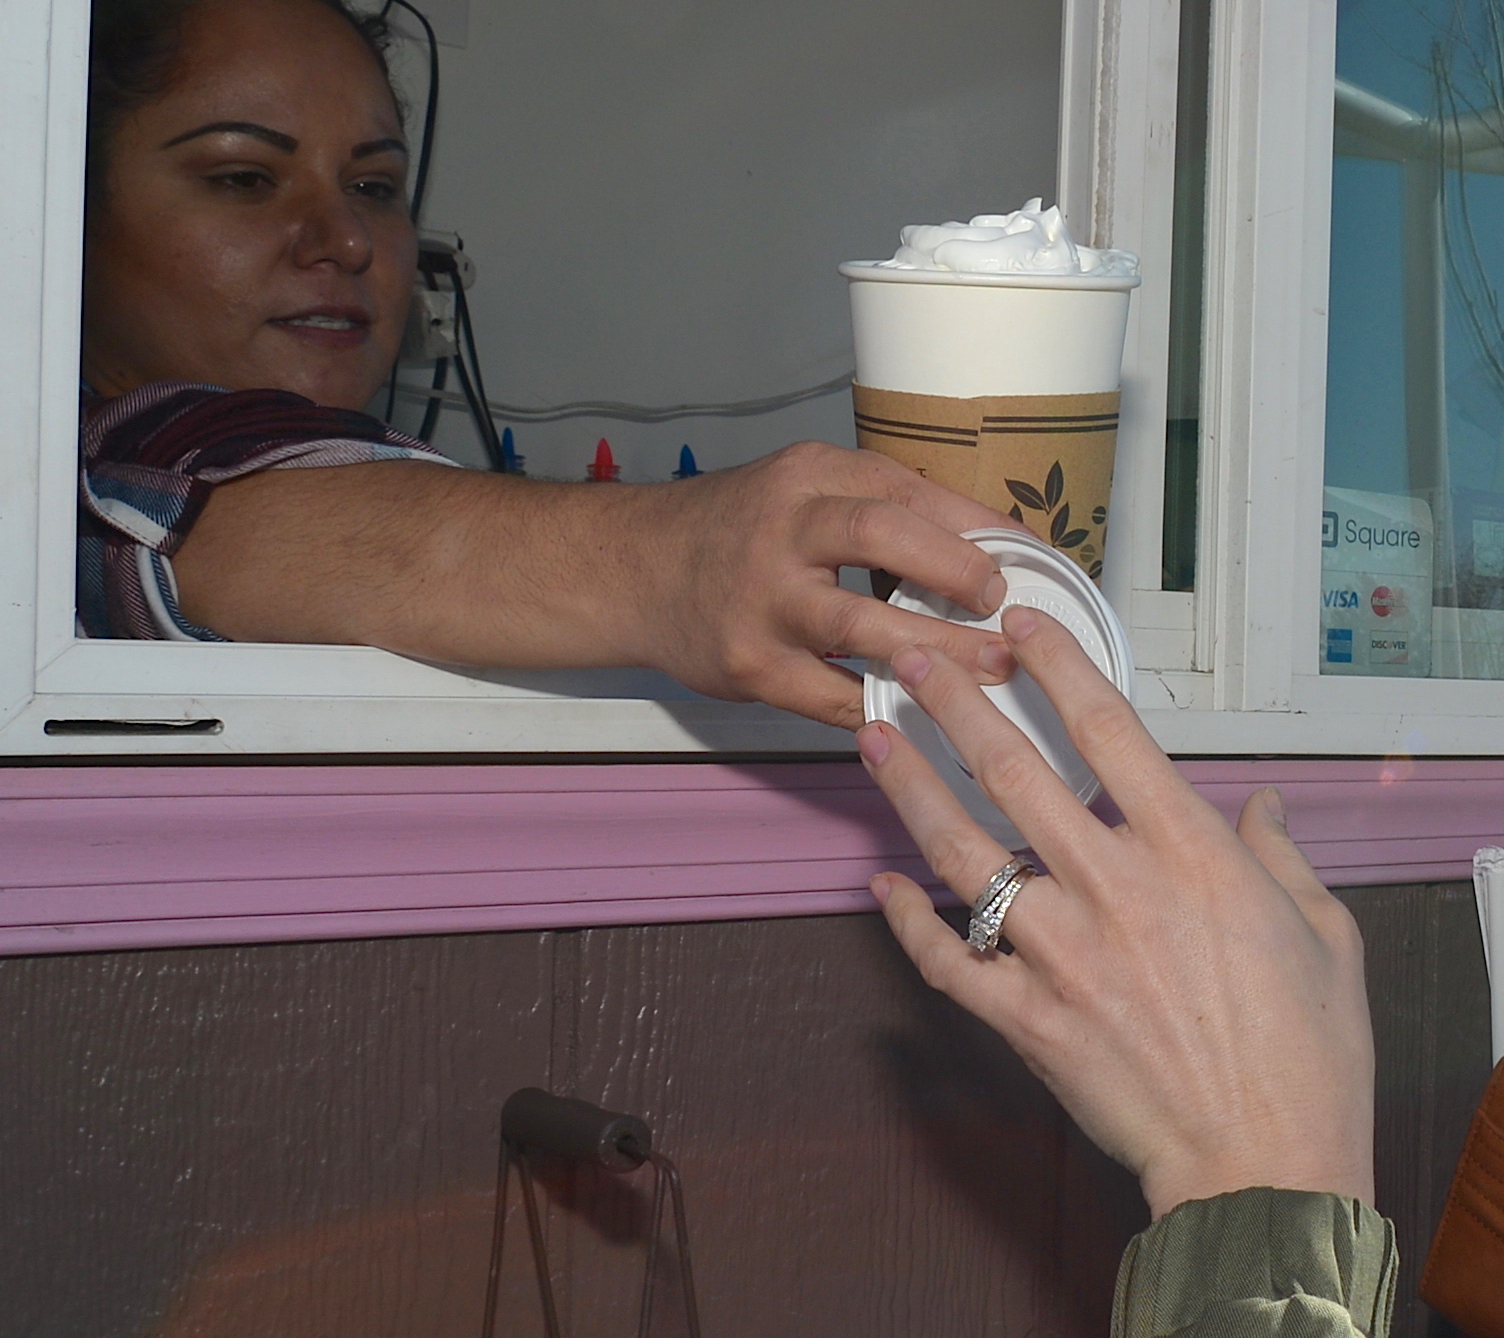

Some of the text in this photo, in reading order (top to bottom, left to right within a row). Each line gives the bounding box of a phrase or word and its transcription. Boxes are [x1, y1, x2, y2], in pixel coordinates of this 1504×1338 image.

[1345, 519, 1420, 550] Square
[1322, 590, 1360, 609] VISA
[1371, 639, 1407, 651] DISCOVER
